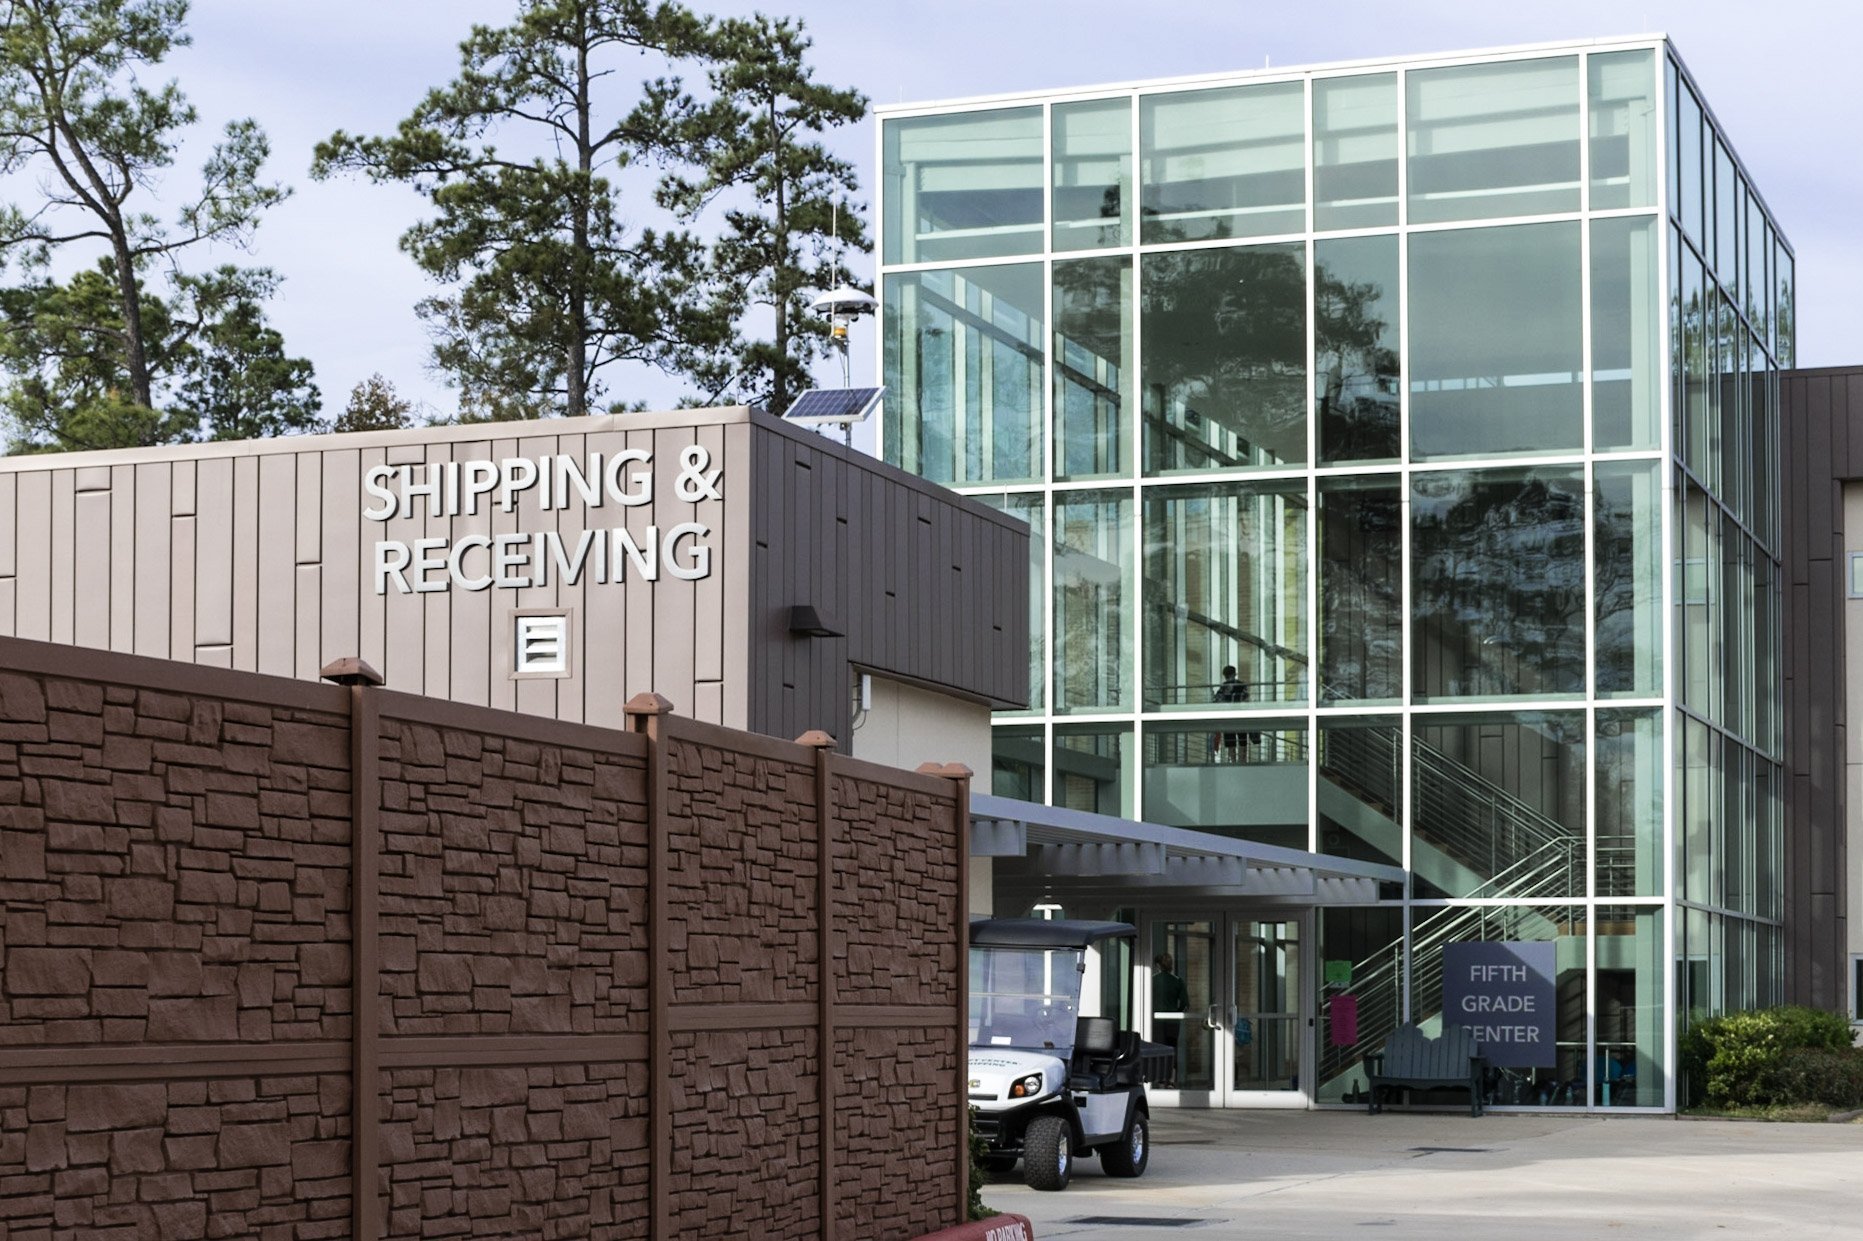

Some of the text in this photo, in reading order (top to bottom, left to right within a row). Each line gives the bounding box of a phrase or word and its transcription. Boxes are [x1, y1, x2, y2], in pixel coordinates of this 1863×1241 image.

[363, 445, 724, 521] SHIPPING &
[374, 522, 712, 595] RECEIVING
[1470, 965, 1527, 982] FIFTH
[1462, 995, 1536, 1013] GRADE
[1462, 1025, 1540, 1043] ENTER
